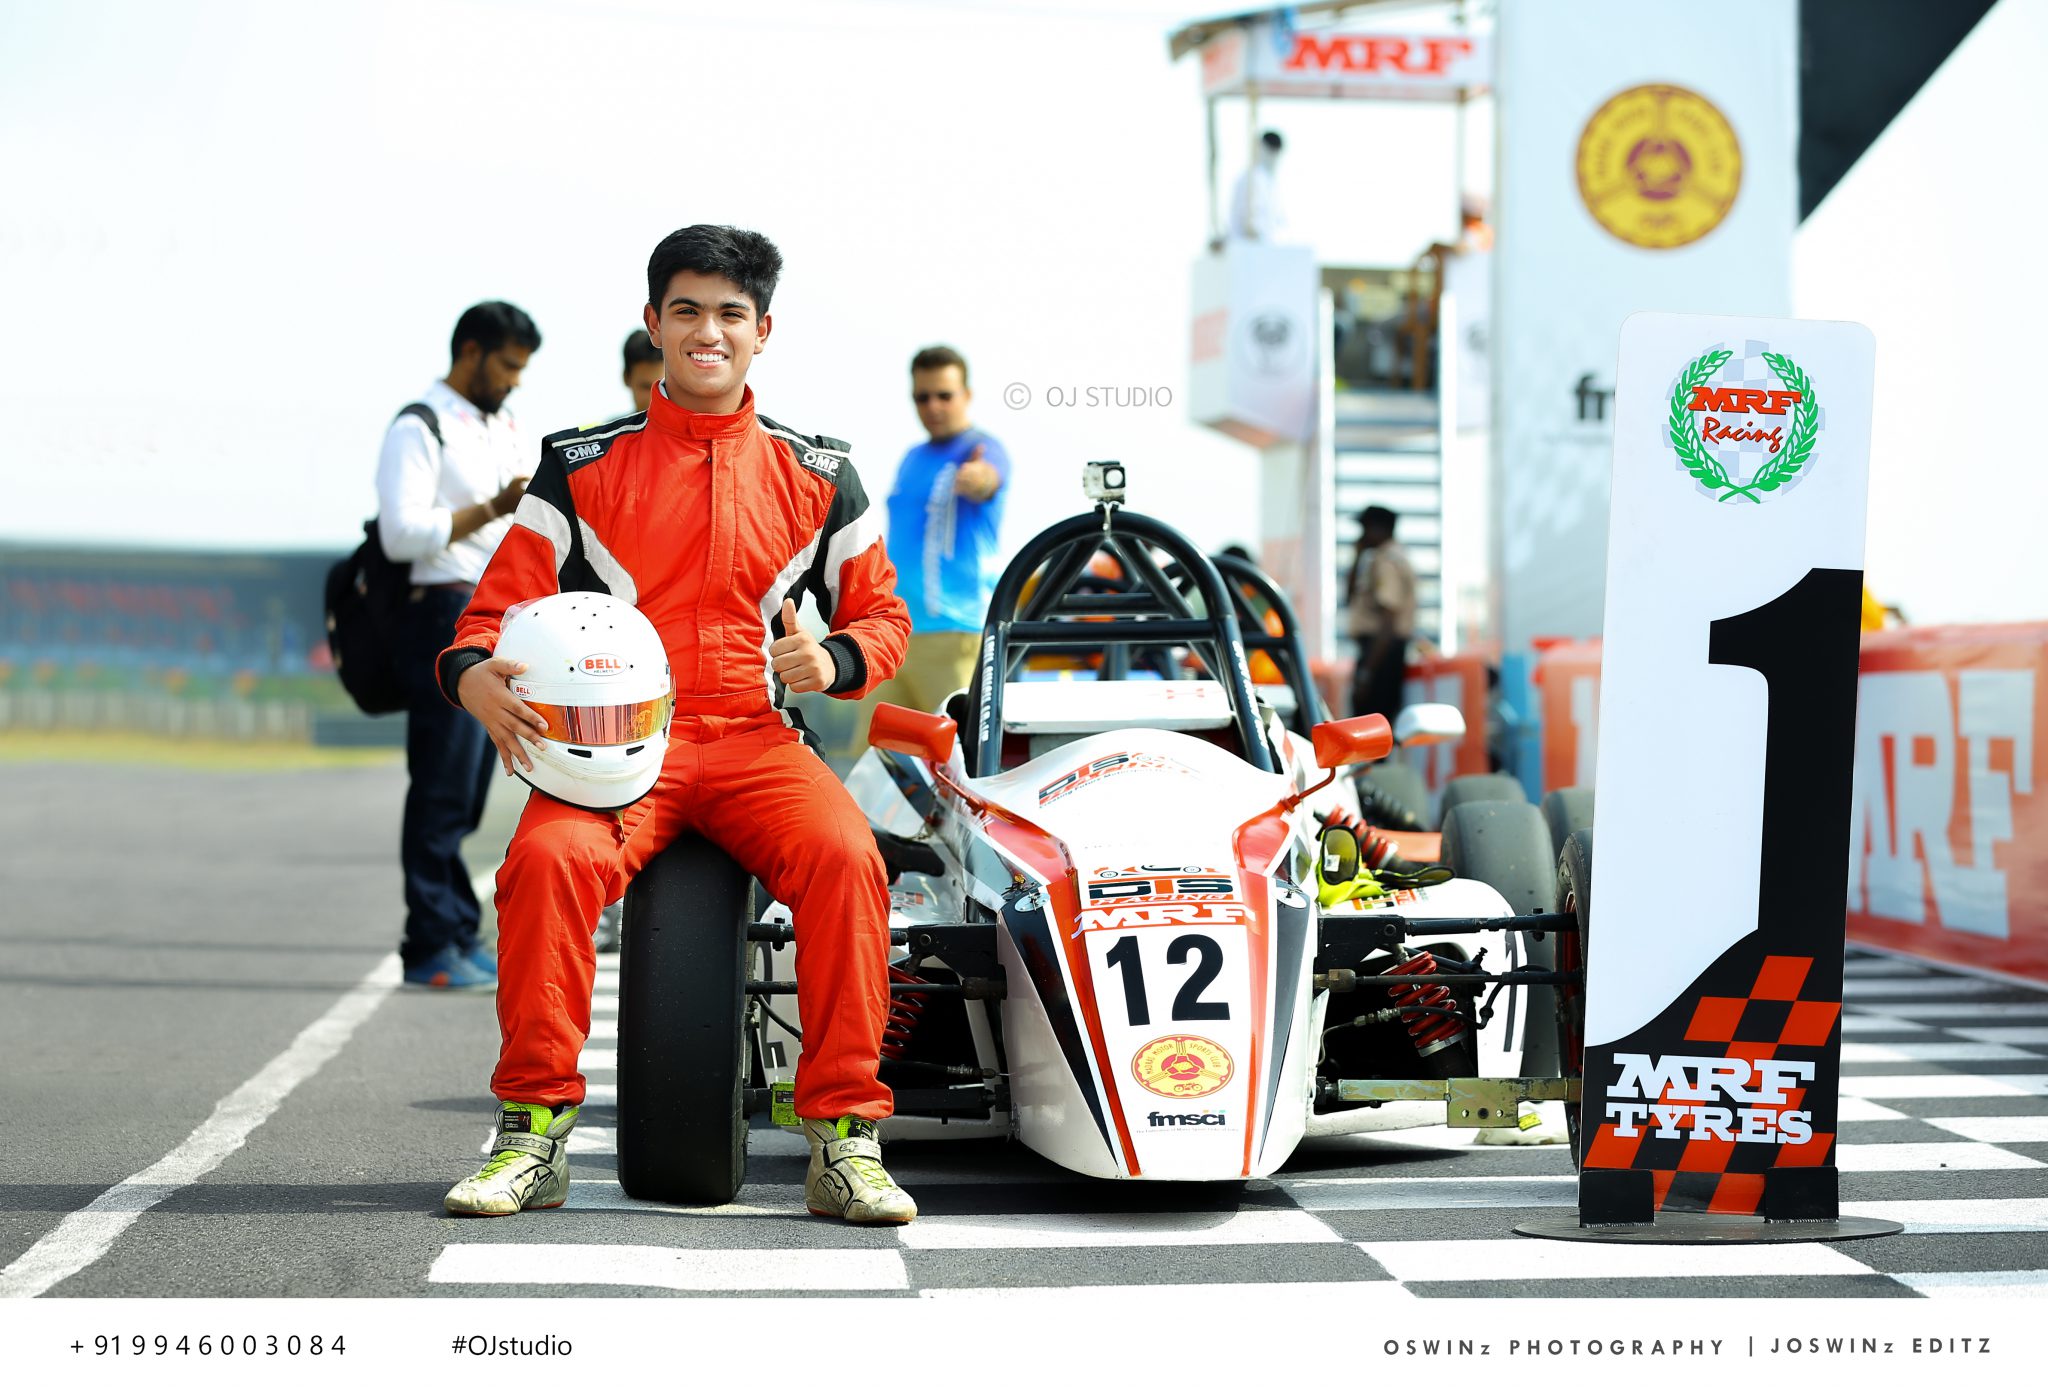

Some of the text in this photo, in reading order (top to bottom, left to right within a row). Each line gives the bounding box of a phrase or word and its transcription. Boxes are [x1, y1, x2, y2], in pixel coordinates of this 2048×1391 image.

[1285, 34, 1473, 75] MRF
[1688, 386, 1802, 415] MRF
[565, 444, 601, 458] OMP
[1702, 416, 1783, 453] Racing
[803, 450, 839, 472] OMP
[585, 659, 621, 669] BELL
[516, 686, 531, 695] BELL
[1708, 568, 1864, 945] 1
[1073, 904, 1257, 938] MRF
[1105, 933, 1231, 1026] 12
[1606, 1053, 1816, 1104] MRF
[1147, 1110, 1226, 1127] fmsci
[1605, 1102, 1813, 1145] TYRES
